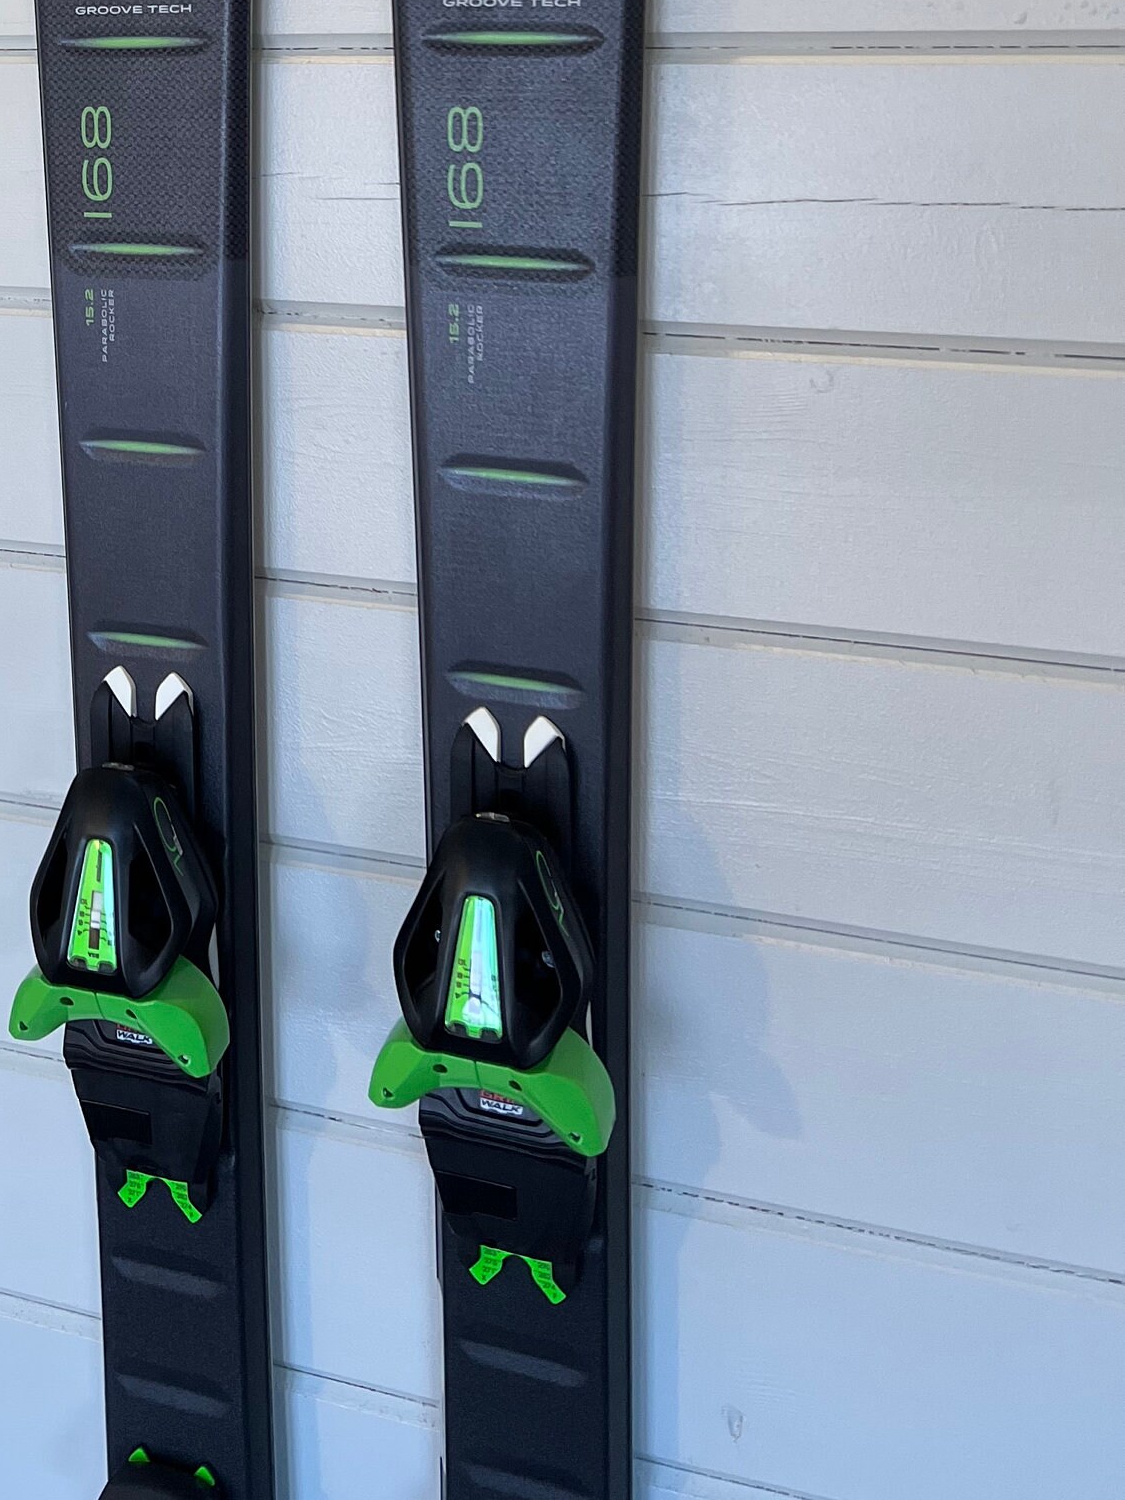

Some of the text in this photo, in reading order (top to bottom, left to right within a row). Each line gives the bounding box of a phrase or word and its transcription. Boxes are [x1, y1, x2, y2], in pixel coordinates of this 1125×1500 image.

[75, 3, 192, 16] GROOVE TECH
[81, 106, 113, 219] 168
[448, 106, 484, 228] 168
[84, 288, 95, 327] 15.2
[100, 289, 108, 363] PARABOLIC
[448, 303, 459, 344] 15.2
[467, 304, 475, 384] PARABOLIC
[476, 305, 484, 362] ROCKER
[117, 1030, 152, 1043] WALK
[481, 1098, 522, 1113] WALK
